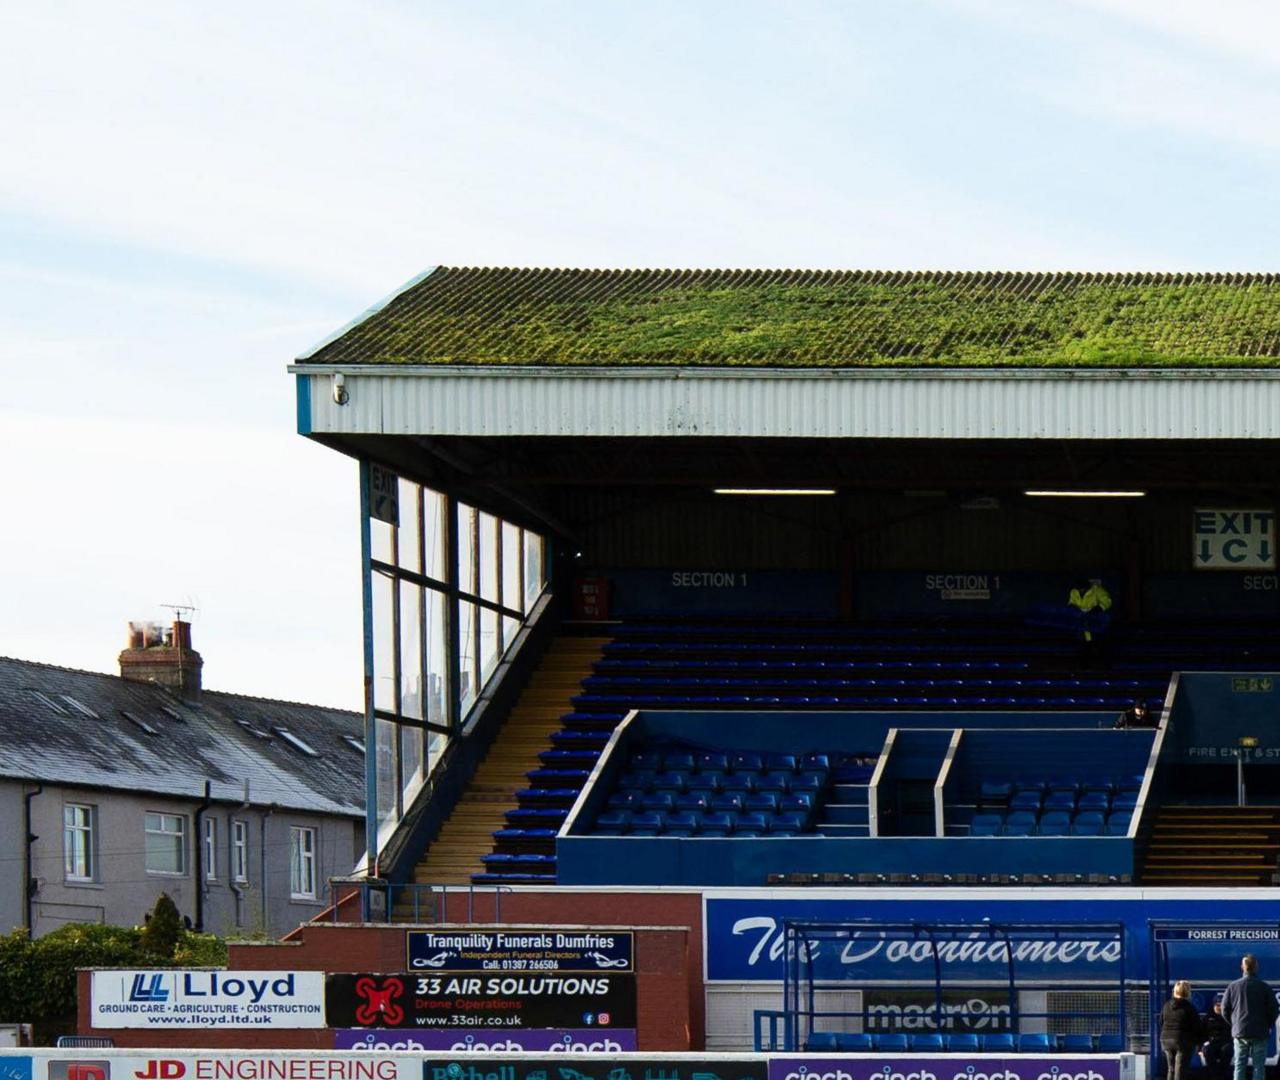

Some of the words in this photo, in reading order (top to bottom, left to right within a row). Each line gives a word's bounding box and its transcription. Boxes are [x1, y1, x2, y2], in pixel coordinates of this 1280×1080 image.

[1195, 512, 1275, 534] EXIT
[1222, 538, 1247, 563] C
[672, 572, 735, 588] SECTION
[741, 572, 748, 588] 1
[926, 575, 987, 590] SECTION
[1189, 747, 1216, 757] FIRE
[427, 934, 493, 951] Tranquility
[497, 934, 553, 949] Funerals
[557, 934, 614, 949] Dumfries
[1188, 930, 1228, 940] FORREST
[1230, 930, 1279, 940] PRECISION
[460, 951, 511, 960] Independent
[513, 951, 542, 959] Funeral
[545, 951, 580, 959] Directors
[503, 960, 527, 970] 01387
[184, 973, 294, 1003] Lloyd
[415, 979, 441, 995] 33
[446, 979, 481, 995] AIR
[486, 978, 610, 995] SOLUTIONS
[173, 1004, 239, 1014] AGRICULTURE
[247, 1004, 321, 1014] CONSTRUCTION
[415, 1000, 452, 1010] Drone
[456, 1000, 522, 1011] Operations
[148, 1015, 272, 1026] www.lloyd.ltd.uk
[415, 1015, 522, 1025] www.33air.co.uk
[868, 1000, 1012, 1030] macron
[135, 1060, 186, 1079] JD
[196, 1060, 398, 1080] ENGINEERING
